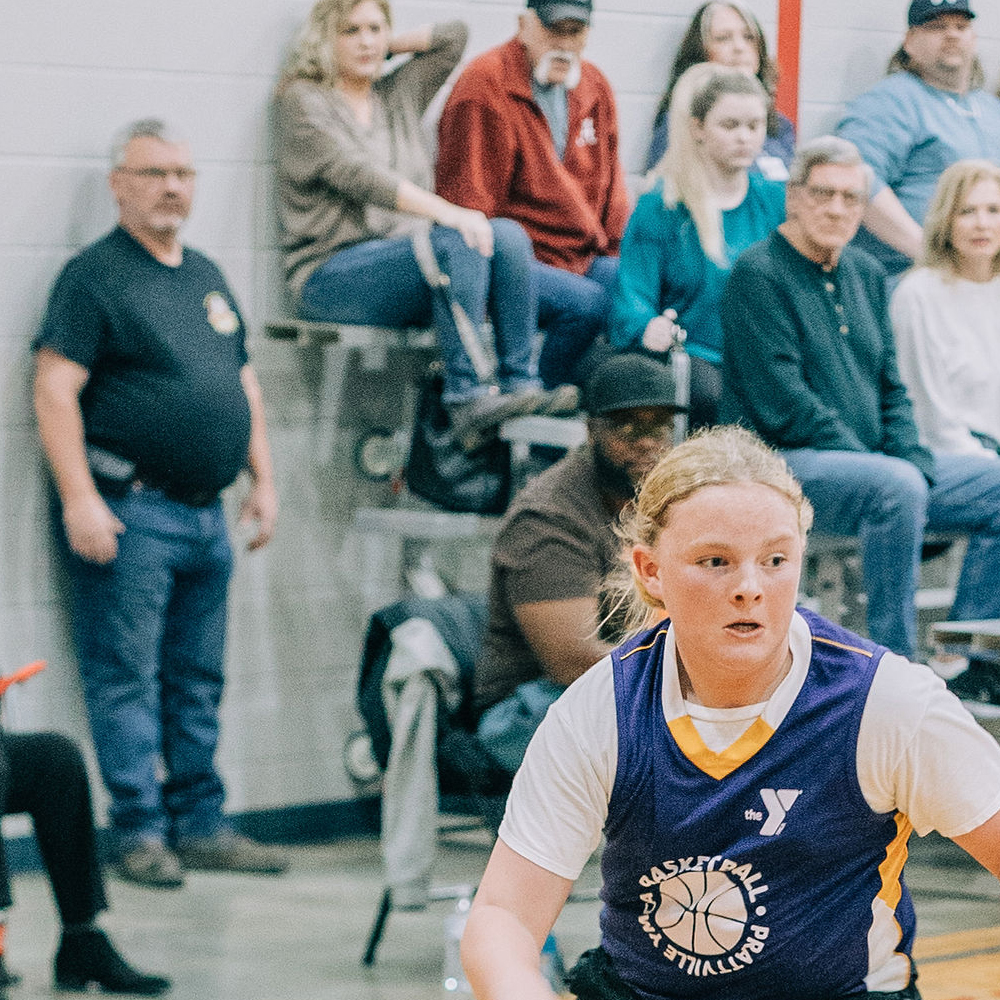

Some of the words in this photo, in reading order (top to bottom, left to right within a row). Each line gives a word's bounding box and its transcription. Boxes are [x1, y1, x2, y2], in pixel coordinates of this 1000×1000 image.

[744, 808, 763, 821] the
[759, 788, 800, 836] Y
[639, 855, 769, 904] BASKETBALL
[663, 925, 770, 977] PRATTVILLE
